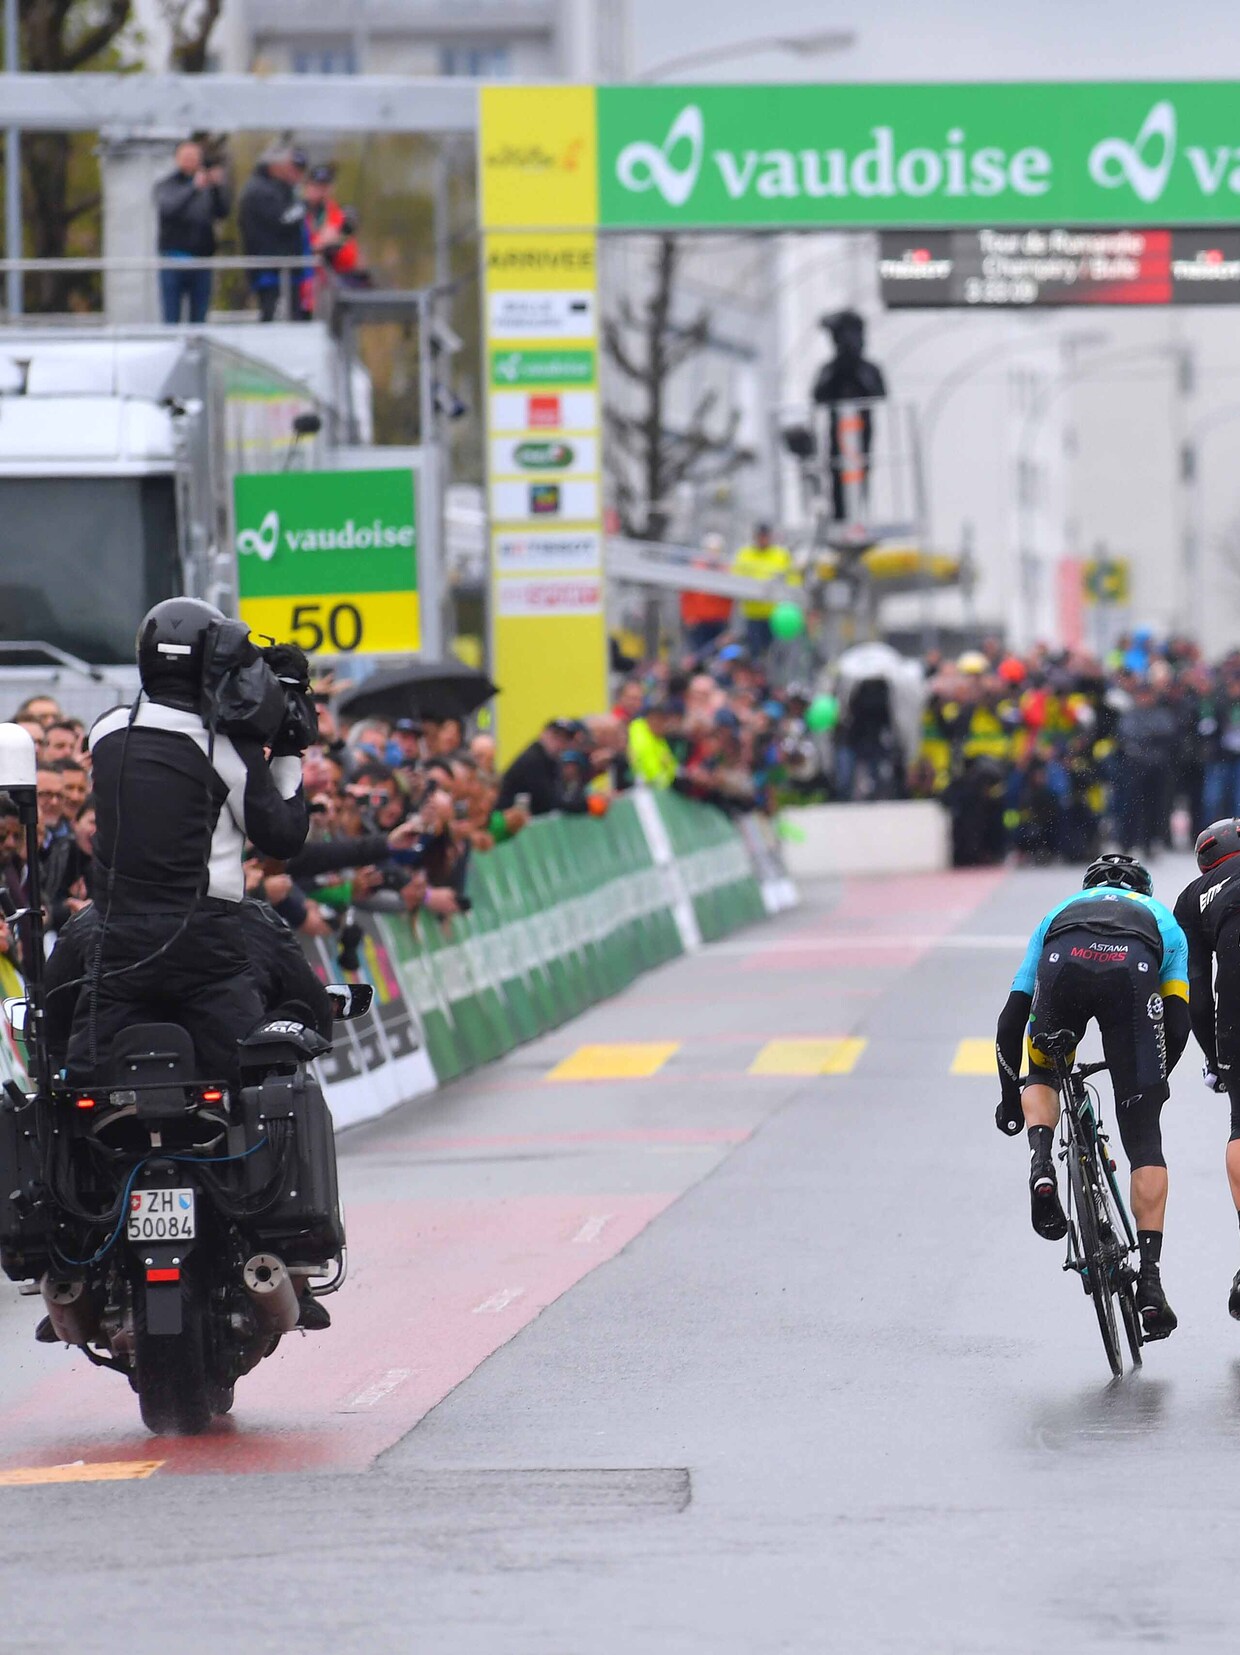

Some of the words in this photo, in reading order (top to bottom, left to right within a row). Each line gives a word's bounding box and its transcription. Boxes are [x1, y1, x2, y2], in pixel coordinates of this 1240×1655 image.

[714, 126, 1052, 199] vaudoise
[284, 519, 416, 552] vaudoise
[290, 602, 363, 653] 50
[1070, 947, 1128, 963] MOTORS
[1088, 942, 1129, 953] ASTANA
[147, 1192, 173, 1213] ZH
[128, 1215, 193, 1239] 50084
